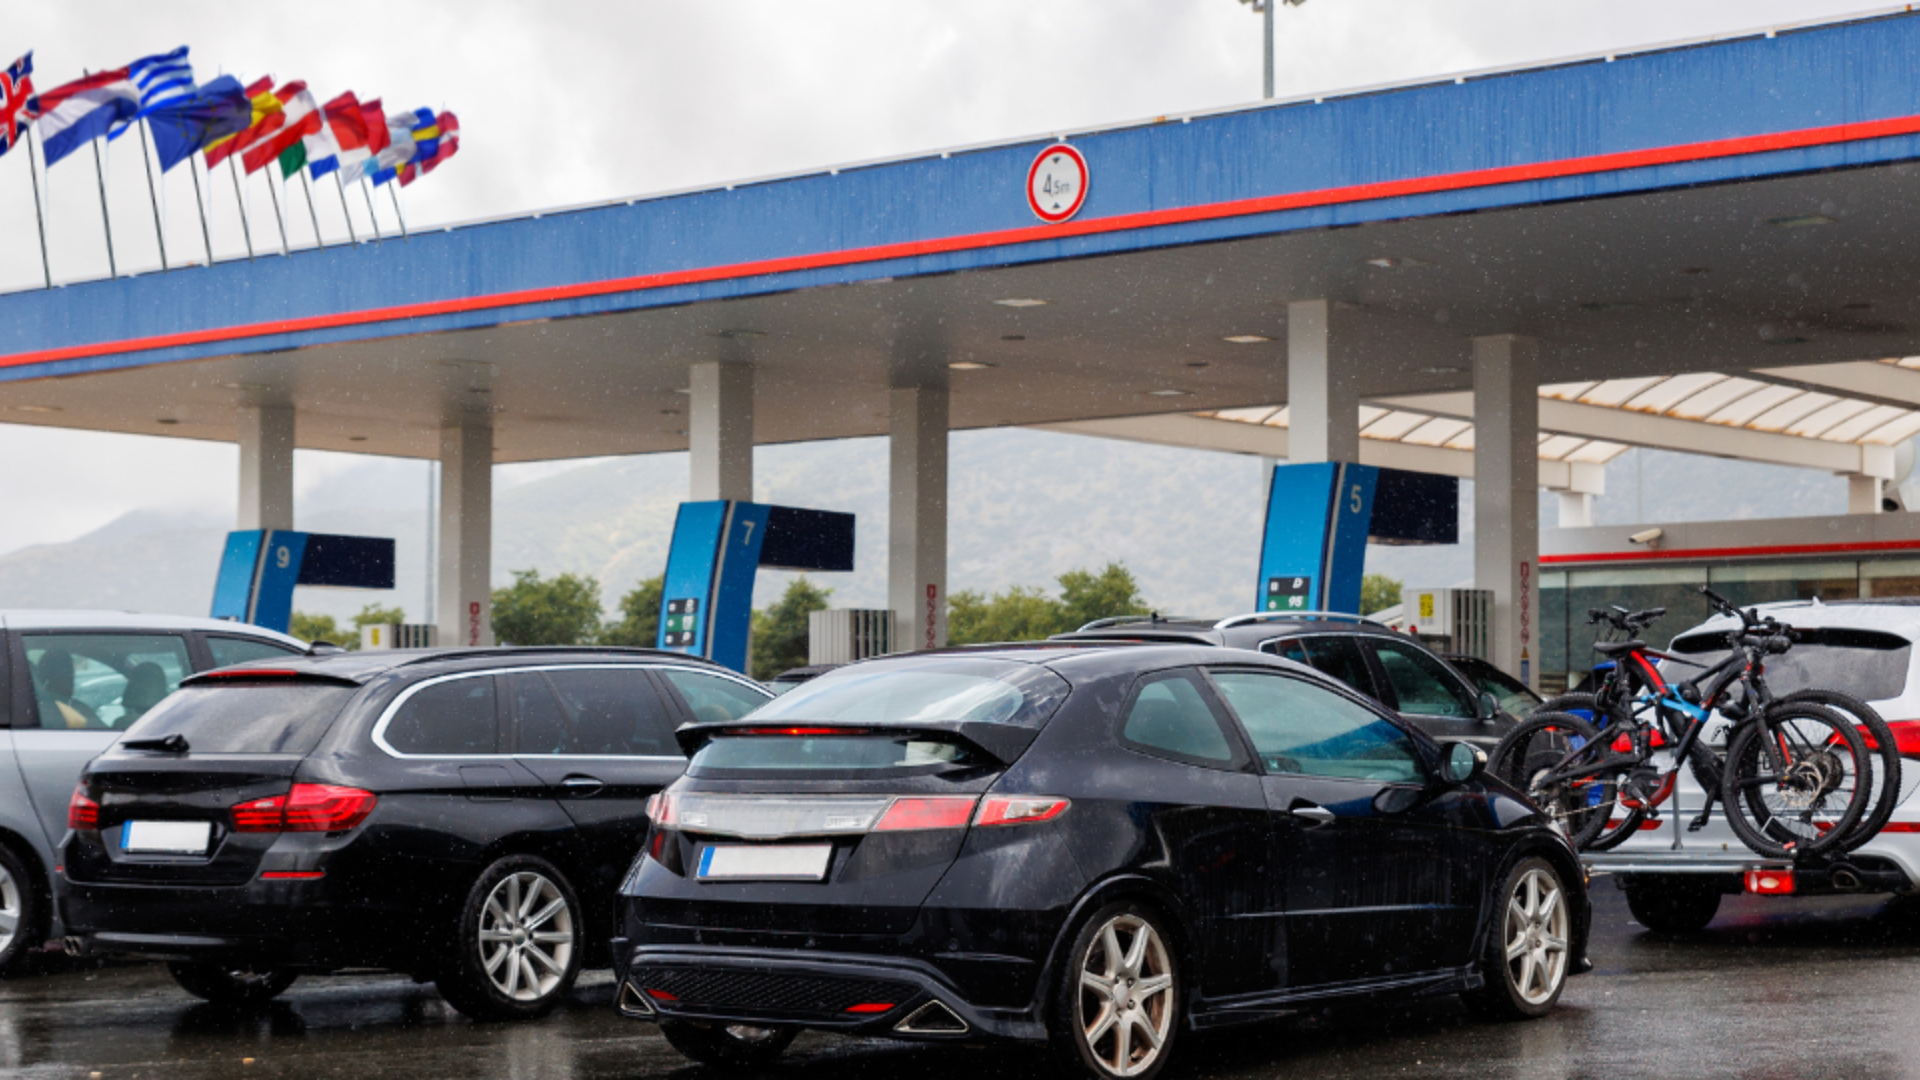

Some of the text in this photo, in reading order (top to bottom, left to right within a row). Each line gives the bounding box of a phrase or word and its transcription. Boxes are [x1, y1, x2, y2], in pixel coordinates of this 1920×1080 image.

[1350, 484, 1362, 514] 5
[742, 519, 756, 546] 7
[276, 545, 290, 569] 9
[1292, 577, 1304, 589] D
[1288, 595, 1304, 608] 95
